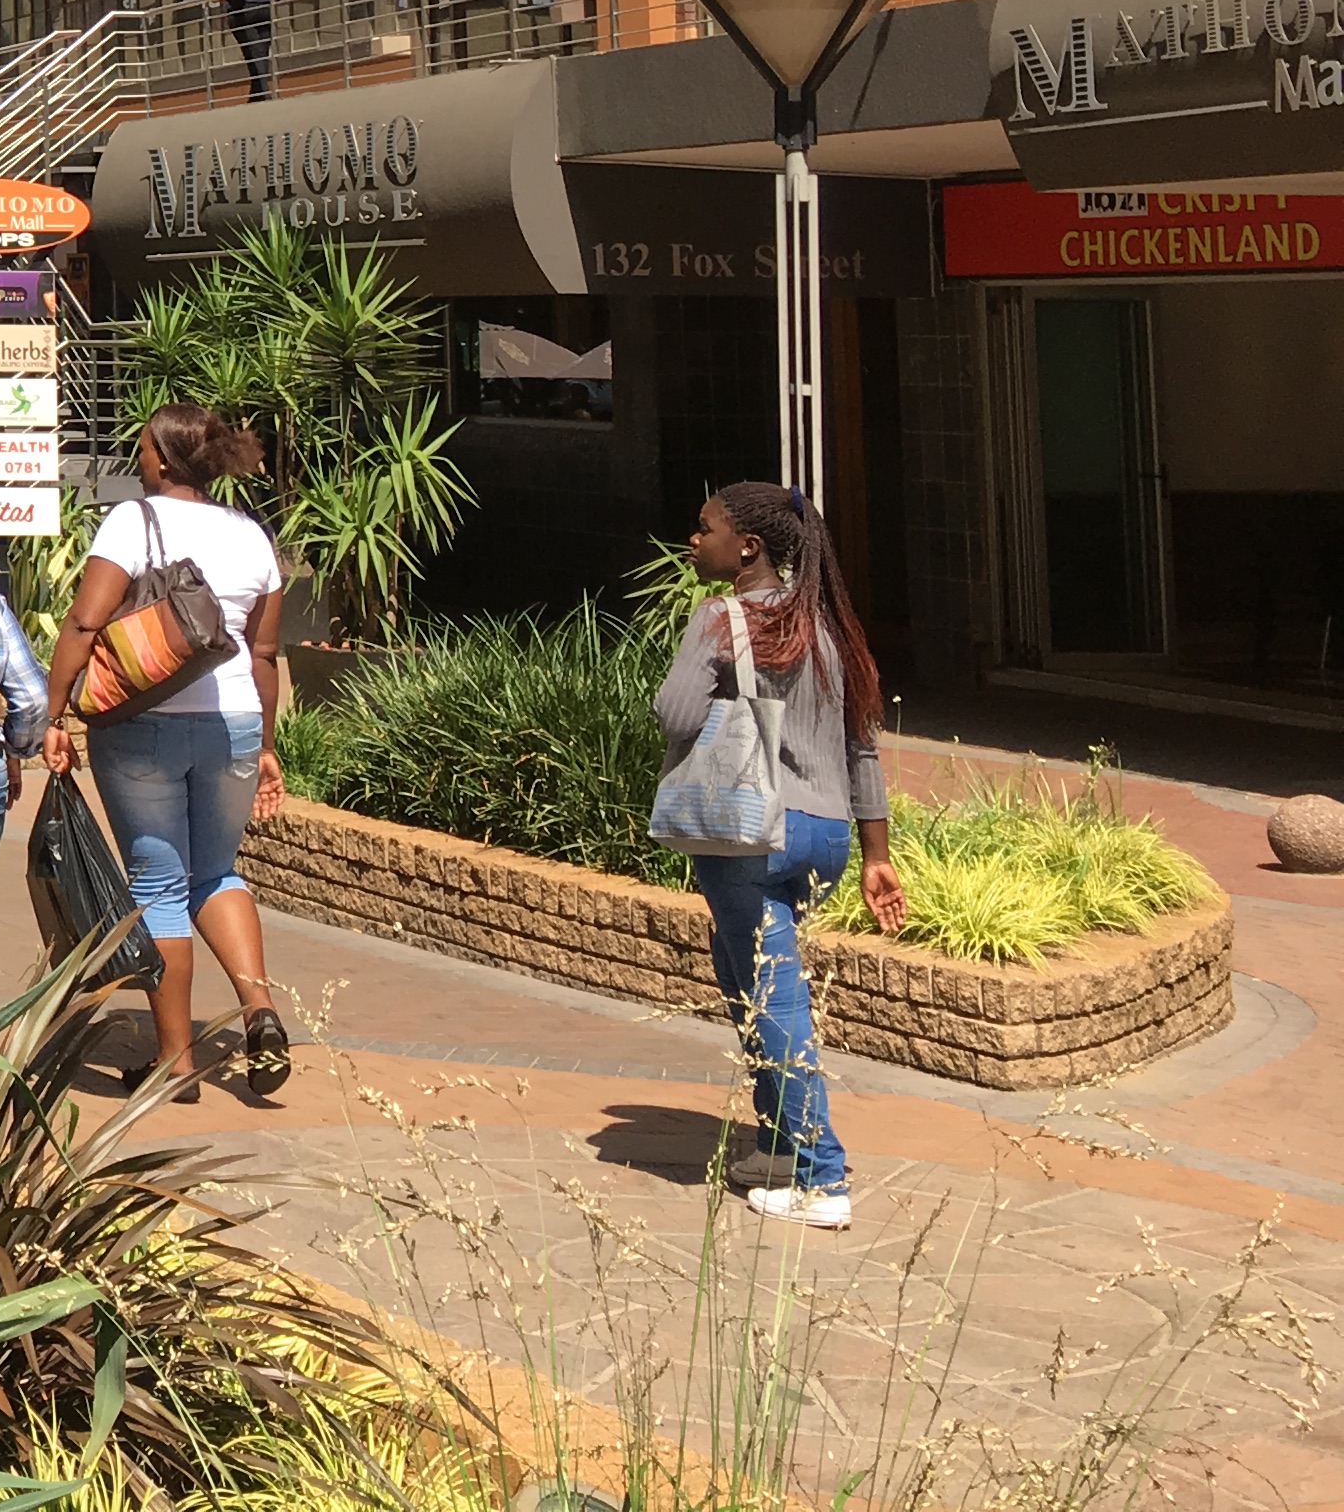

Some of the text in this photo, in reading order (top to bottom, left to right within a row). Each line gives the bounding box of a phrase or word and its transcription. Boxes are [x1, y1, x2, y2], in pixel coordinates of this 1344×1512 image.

[144, 115, 420, 238] MATHOMO
[9, 214, 44, 231] Mall
[592, 242, 652, 277] 132
[667, 242, 736, 278] Fox
[1059, 222, 1321, 268] CHICKENLAND
[4, 462, 42, 473] 0781
